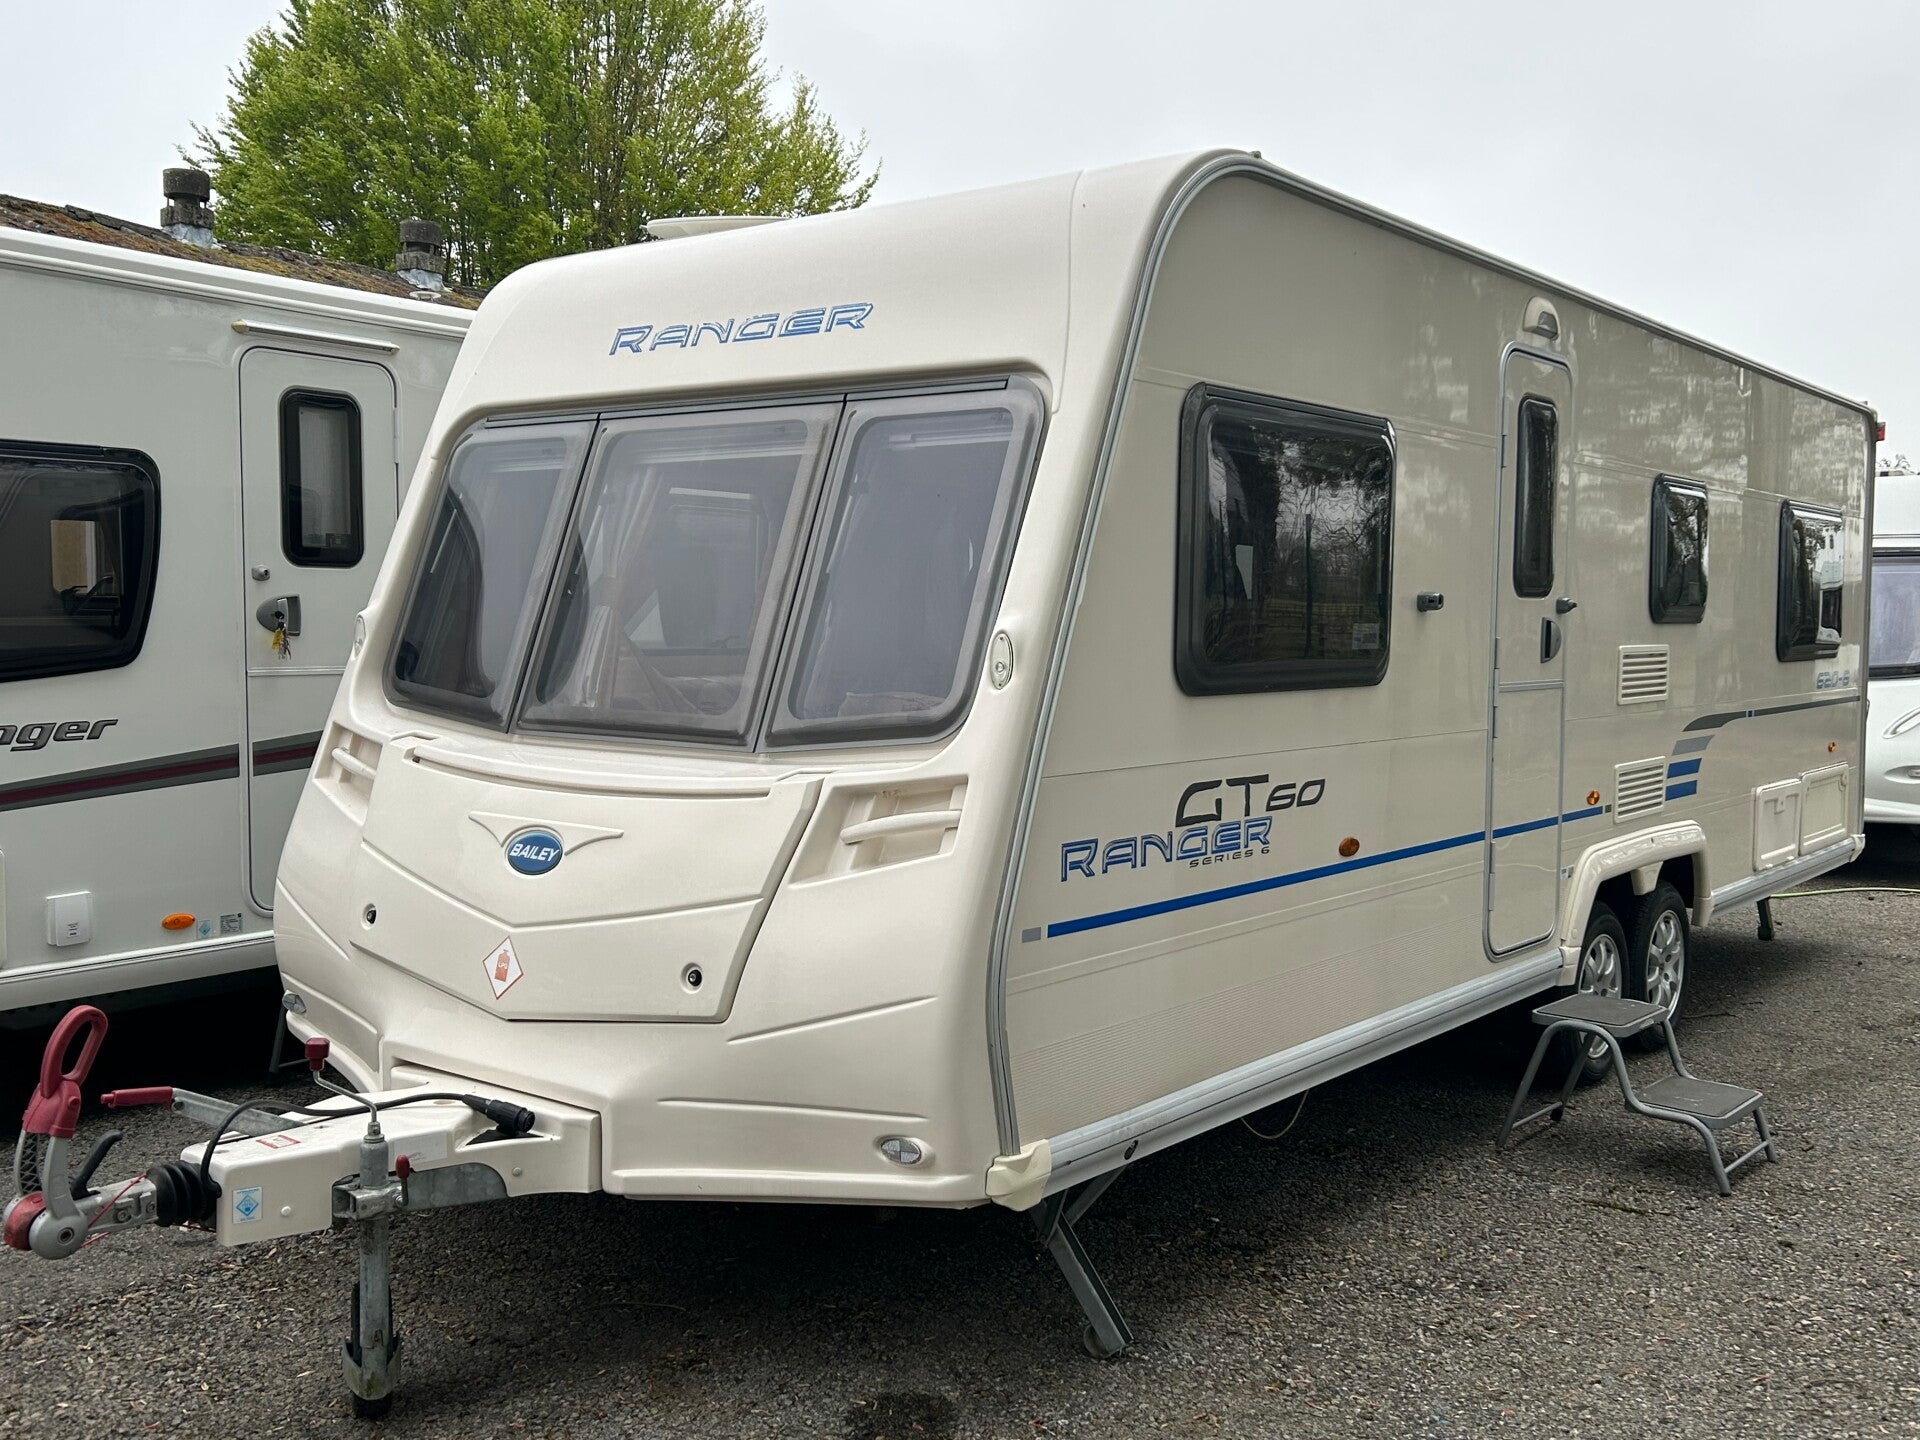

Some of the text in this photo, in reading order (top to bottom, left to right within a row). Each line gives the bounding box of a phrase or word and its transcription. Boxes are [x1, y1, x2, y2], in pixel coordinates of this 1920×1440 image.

[609, 302, 874, 356] RANGER
[509, 843, 560, 862] BAILEY
[1061, 816, 1272, 882] RANGER
[1189, 846, 1271, 868] SERIES 6
